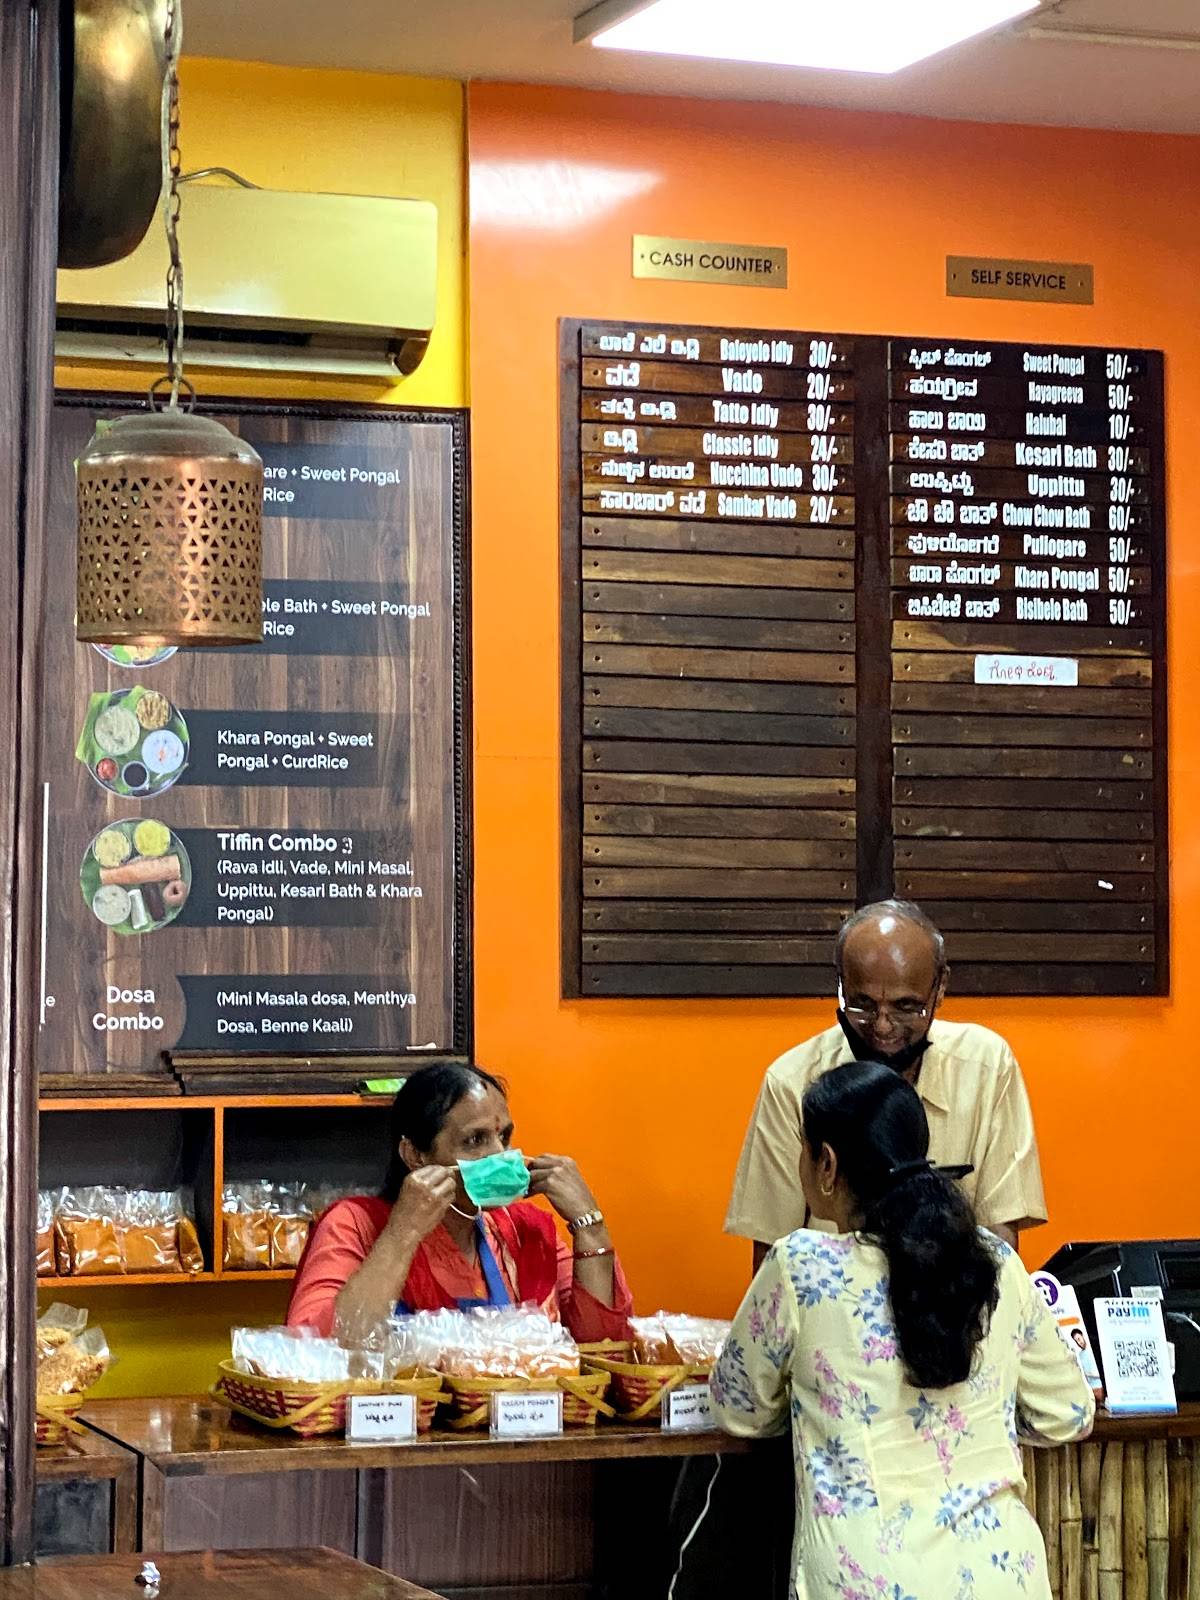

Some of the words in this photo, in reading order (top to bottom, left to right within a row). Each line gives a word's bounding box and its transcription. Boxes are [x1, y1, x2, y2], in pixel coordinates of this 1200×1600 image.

[649, 250, 694, 268] CASH
[699, 253, 774, 274] COUNTER
[971, 269, 1003, 286] SELF
[1006, 271, 1067, 290] SERVICE
[771, 341, 794, 366] Idly
[809, 340, 838, 369] 30/-
[1023, 353, 1051, 373] Sweet
[1051, 356, 1085, 377] Pongal
[1105, 354, 1132, 380] 50/-
[605, 363, 641, 387] ವಡೆ
[722, 368, 763, 394] Vade
[807, 372, 835, 401] 20/-
[1028, 382, 1084, 405] Hayagreeva
[1108, 385, 1134, 410] 50/-
[712, 400, 749, 425] Tatte
[751, 402, 779, 428] Idly
[807, 403, 836, 432] 30/-
[1025, 412, 1067, 437] Halubai
[1108, 414, 1135, 441] 10/-
[702, 432, 752, 456] Classic
[753, 434, 779, 459] Idly
[810, 435, 838, 463] 24/-
[1015, 444, 1062, 467] Kesari
[1064, 445, 1097, 469] Bath
[1107, 446, 1134, 473] 30/-
[301, 465, 346, 483] Sweet
[349, 465, 401, 486] Pongal
[710, 461, 769, 487] Nucchina
[770, 464, 803, 488] Unde
[812, 464, 839, 492] 30/-
[263, 487, 295, 503] Rice
[1028, 474, 1085, 498] Uppittu
[1110, 477, 1135, 503] 30/-
[717, 492, 765, 518] Sambar
[766, 495, 797, 519] Vade
[809, 496, 838, 523] 20/-
[1003, 503, 1034, 527] Chow
[1034, 504, 1065, 528] Chow
[1065, 506, 1091, 529] Bath
[1108, 508, 1135, 532] 60/-
[1023, 534, 1086, 559] Puliogare
[1109, 537, 1136, 563] 50/-
[1014, 567, 1049, 589] Khara
[1051, 568, 1099, 592] Pongal
[1108, 567, 1135, 593] 50/-
[284, 599, 318, 614] Bath
[331, 600, 377, 616] Sweet
[380, 602, 431, 620] Pongal
[1016, 598, 1062, 621] Bisibele
[1063, 600, 1088, 622] Bath
[1109, 599, 1136, 625] 50/-
[263, 621, 295, 637] Rice
[217, 730, 262, 747] Khara
[263, 731, 315, 748] Pongal
[328, 732, 374, 747] Sweet
[217, 753, 270, 771] Pongal
[282, 754, 349, 770] CurdRice
[217, 833, 264, 852] Tiffin
[268, 834, 338, 853] Combo
[217, 860, 260, 876] (Rava
[290, 860, 331, 877] Vade,
[334, 860, 365, 875] Mini
[217, 883, 277, 901] Uppittu,
[279, 883, 326, 898] Kesari
[328, 883, 363, 898] Bath
[366, 883, 376, 898] &
[380, 883, 423, 898] Khara
[217, 906, 274, 924] Pongal)
[106, 986, 156, 1004] Dosa
[216, 991, 253, 1008] (Mini
[255, 991, 309, 1006] Masala
[311, 991, 352, 1007] dosa,
[353, 992, 417, 1009] Menthya
[92, 1013, 164, 1031] Combo
[217, 1019, 259, 1035] Dosa,
[261, 1019, 309, 1034] Benne
[312, 1018, 353, 1034] Kaali)
